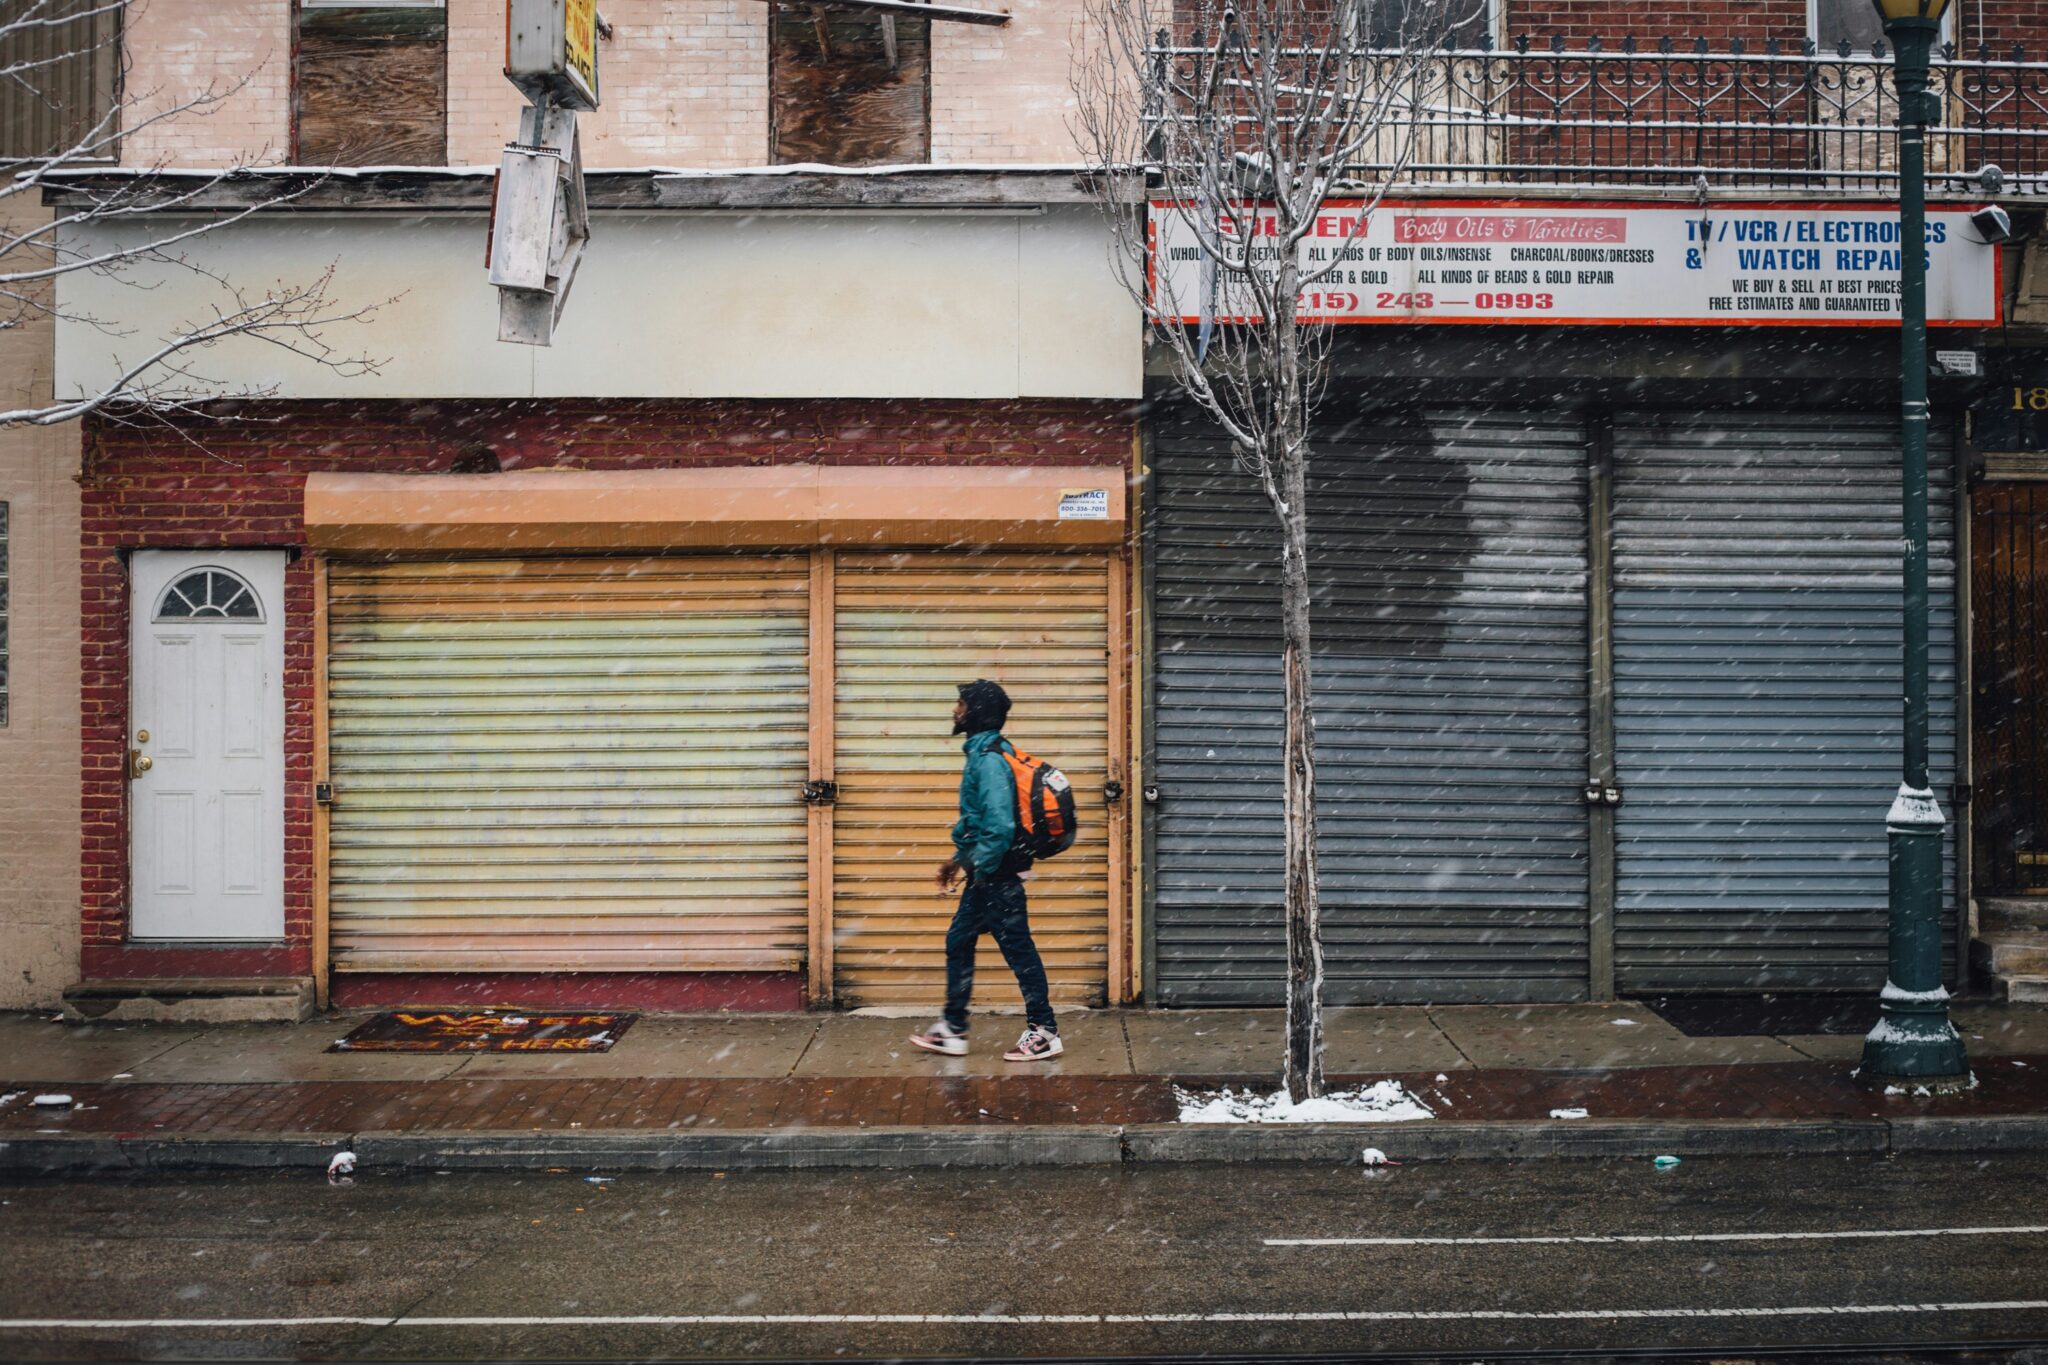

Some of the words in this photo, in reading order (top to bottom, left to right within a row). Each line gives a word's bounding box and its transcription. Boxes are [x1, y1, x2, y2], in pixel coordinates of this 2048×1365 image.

[1402, 217, 1447, 241] Body
[1456, 217, 1495, 238] Oils
[1502, 218, 1518, 238] &
[1525, 218, 1617, 240] Varieties
[1237, 247, 1245, 261] &
[1250, 247, 1281, 261] RETAI
[1308, 248, 1327, 261] ALL
[1332, 248, 1364, 262] KINDS
[1369, 248, 1381, 261] OF
[1387, 248, 1415, 262] BODY
[1420, 248, 1492, 262] OILS/INSENSE
[1510, 247, 1654, 263] CHARCOAL/BOOKS/DRESSES
[1686, 248, 1703, 269] &
[1738, 249, 1820, 270] WATCH
[1348, 270, 1356, 284] &
[1362, 270, 1388, 284] GOLD
[1418, 270, 1436, 284] ALL
[1441, 270, 1472, 284] KINDS
[1477, 270, 1490, 284] OF
[1495, 270, 1528, 284] BEADS
[1533, 270, 1541, 284] &
[1546, 270, 1571, 284] GOLD
[1577, 270, 1614, 285] REPAIR
[1732, 279, 1749, 293] WE
[1754, 279, 1774, 293] BUY
[1779, 279, 1787, 293] &
[1792, 279, 1815, 293] SELL
[1819, 279, 1833, 293] AT
[1838, 280, 1863, 294] BEST
[1867, 280, 1903, 294] PRICES
[1709, 297, 1733, 310] FREE
[1738, 297, 1794, 311] ESTIMATES
[1799, 297, 1820, 311] AND
[1825, 297, 1890, 312] GUARANTEED
